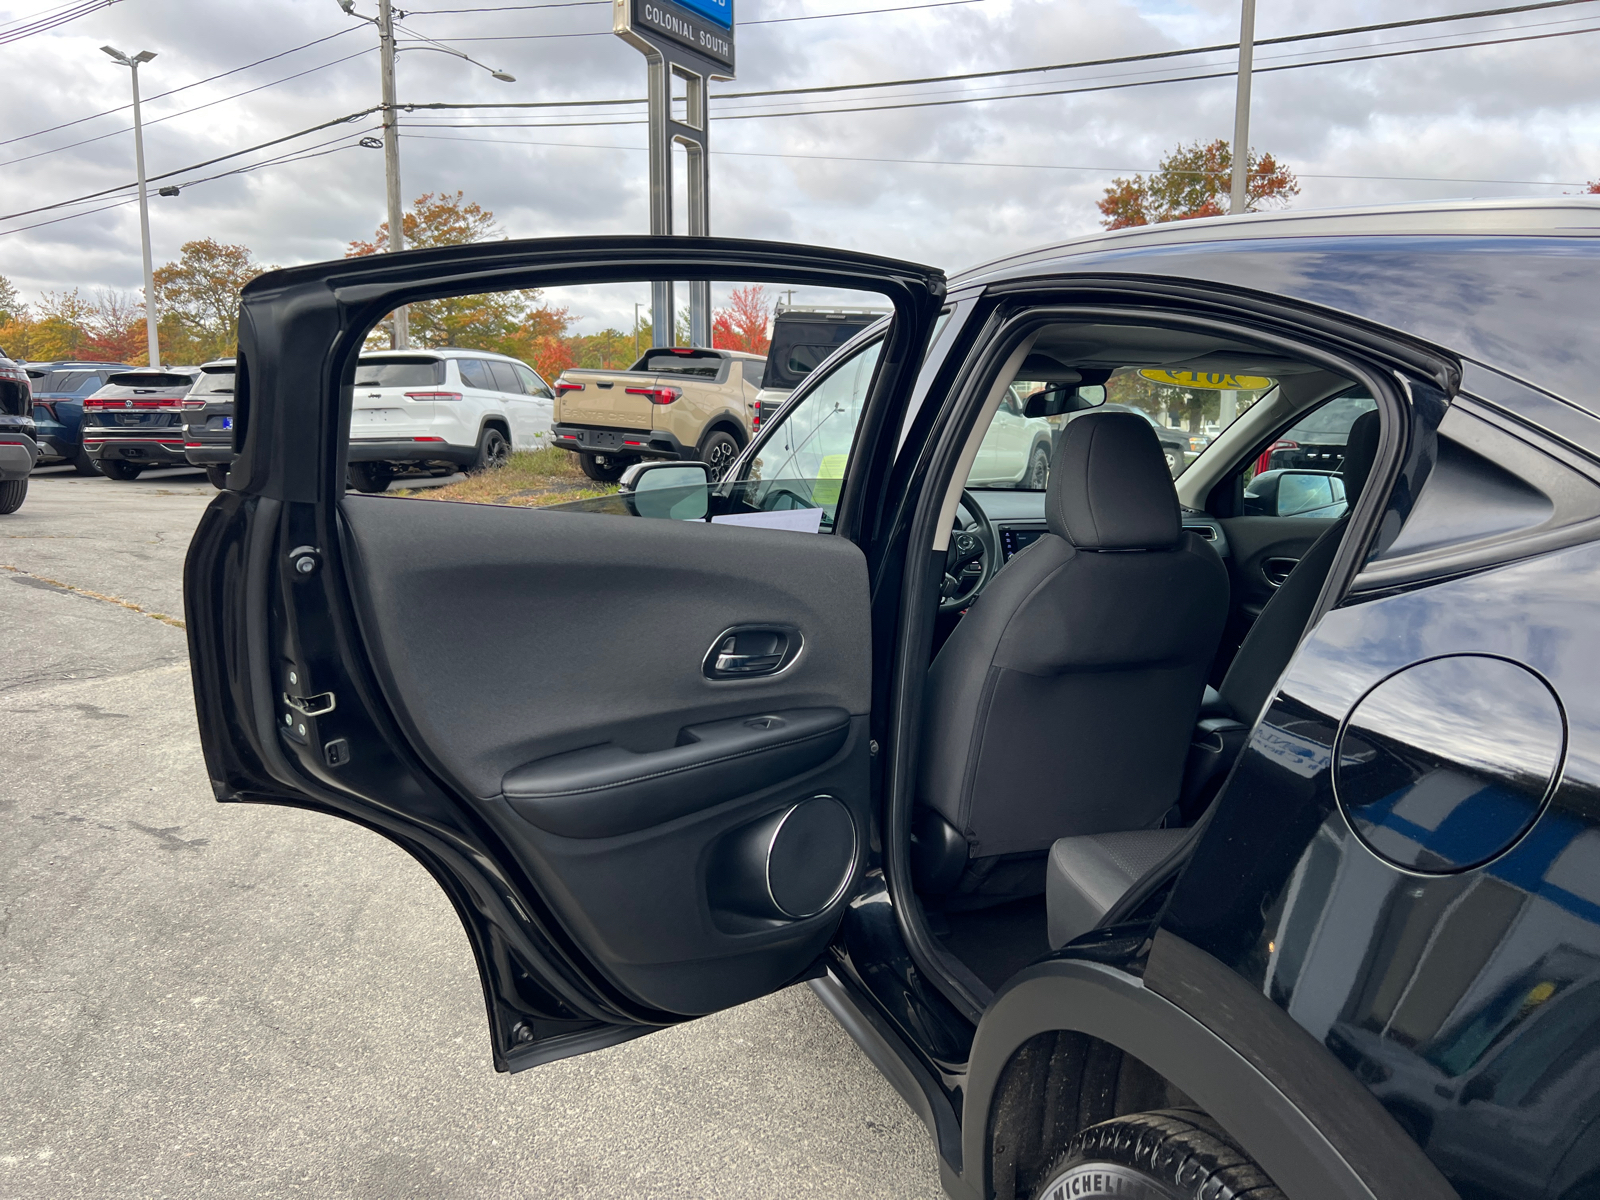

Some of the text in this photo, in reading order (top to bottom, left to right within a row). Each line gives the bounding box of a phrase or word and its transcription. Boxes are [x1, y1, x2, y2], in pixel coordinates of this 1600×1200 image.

[645, 4, 729, 57] COLONIAL SOUTH
[563, 408, 647, 424] SANTA CRUZ
